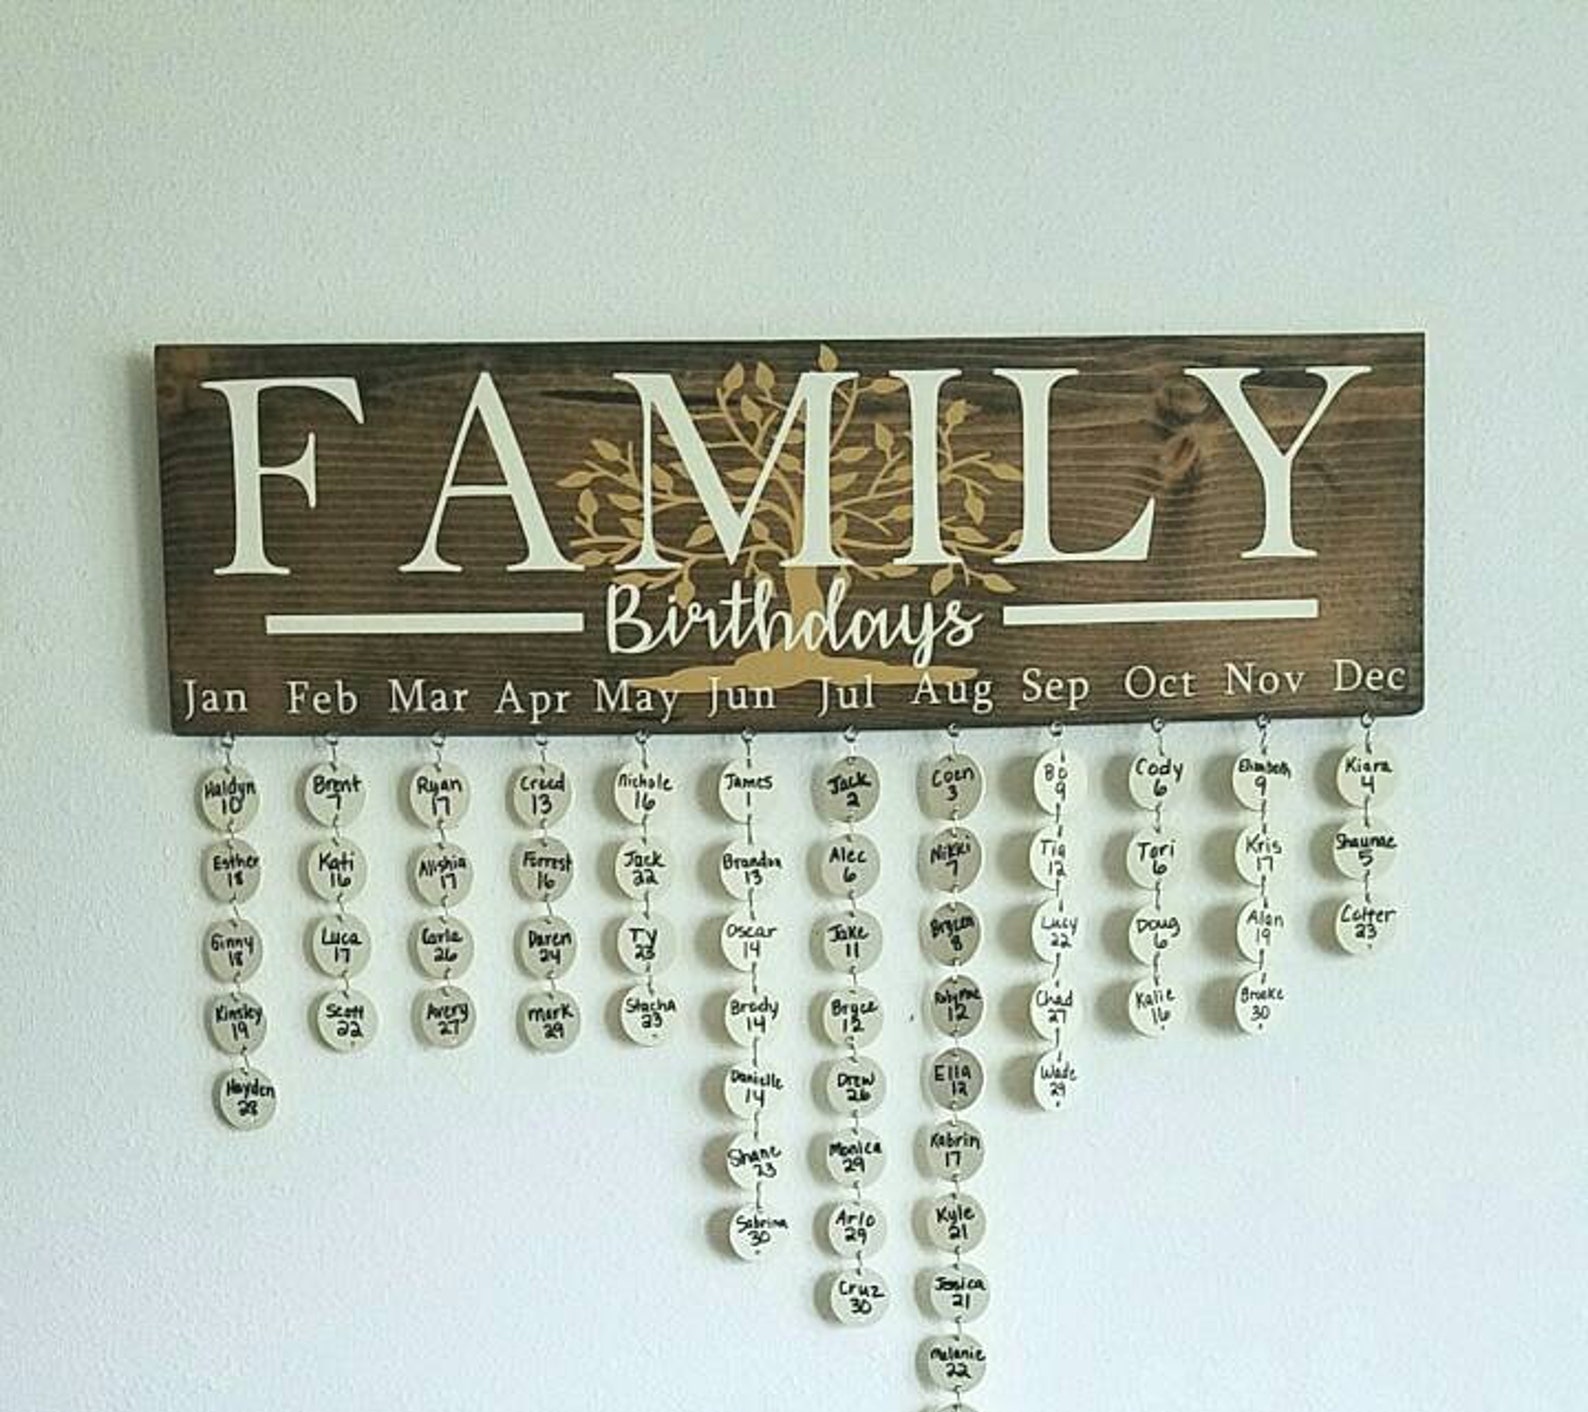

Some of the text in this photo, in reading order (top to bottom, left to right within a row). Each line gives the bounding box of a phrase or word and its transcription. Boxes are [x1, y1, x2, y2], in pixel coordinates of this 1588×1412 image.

[200, 364, 1372, 577] FAMILY
[605, 573, 983, 667] Birthdays
[1123, 665, 1197, 700] Oct
[1225, 661, 1306, 698] Nov
[1333, 658, 1407, 692] Dec
[389, 679, 470, 715] Mar
[706, 676, 777, 718] Jun
[817, 675, 876, 718] Jul
[910, 671, 995, 712] Aug
[1021, 667, 1092, 710] Sep
[183, 678, 249, 721] Jan
[286, 680, 359, 716] Feb
[494, 680, 571, 723] Apr
[594, 679, 679, 723] May
[932, 767, 975, 787] Coen
[1043, 764, 1068, 782] Bo
[1135, 758, 1183, 782] Cody
[313, 774, 362, 794] Brent
[417, 776, 462, 797] Ryan
[724, 773, 773, 789] James
[827, 771, 872, 794] Jack
[1153, 779, 1167, 796] 6
[1254, 776, 1266, 796] 9
[1361, 776, 1375, 794] 4
[846, 792, 860, 807] 2
[946, 786, 958, 801] 3
[1055, 781, 1066, 801] 9
[222, 797, 243, 814] 10
[326, 794, 342, 810] 7
[432, 796, 451, 816] 17
[532, 794, 552, 815] 13
[635, 792, 655, 810] 16
[1138, 839, 1176, 861] Tori
[1246, 833, 1283, 854] Kris
[319, 852, 355, 871] Kati
[624, 851, 666, 868] Jack
[829, 848, 867, 863] Alec
[1256, 855, 1273, 872] 17
[1358, 850, 1373, 867] 5
[843, 867, 856, 883] 6
[945, 860, 958, 876] 7
[1048, 861, 1066, 876] 12
[1153, 860, 1167, 875] 6
[330, 874, 351, 887] 16
[441, 874, 457, 889] 17
[537, 872, 556, 890] 16
[632, 870, 659, 886] 22
[744, 871, 763, 885] 13
[1041, 916, 1078, 935] Lucy
[1136, 917, 1181, 937] Doug
[1246, 910, 1285, 928] Alan
[321, 928, 362, 944] Luca
[727, 924, 777, 938] Oscar
[827, 924, 869, 942] Jake
[1256, 928, 1271, 946] 19
[1355, 924, 1377, 939] 23
[951, 935, 963, 951] 8
[1050, 933, 1072, 948] 22
[1154, 933, 1168, 949] 6
[334, 948, 350, 963] 17
[433, 948, 458, 962] 26
[539, 949, 561, 964] 24
[743, 940, 760, 959] 14
[846, 943, 859, 958] 11
[326, 1004, 364, 1019] Scott
[948, 1003, 970, 1021] 12
[1151, 1008, 1171, 1024] 16
[1251, 1005, 1270, 1021] 30
[337, 1021, 364, 1037] 22
[438, 1020, 460, 1035] 27
[641, 1013, 663, 1028] 23
[747, 1016, 766, 1033] 14
[842, 1017, 865, 1033] 12
[232, 1021, 249, 1040] 19
[543, 1023, 564, 1039] 29
[935, 1064, 971, 1081] Ella
[1041, 1062, 1077, 1081] Wade
[952, 1081, 968, 1096] 12
[1050, 1083, 1066, 1097] 29
[745, 1088, 764, 1108] 14
[843, 1158, 865, 1174] 29
[944, 1151, 961, 1167] 17
[836, 1209, 876, 1227] Arlo
[936, 1207, 975, 1226] Kyle
[749, 1230, 770, 1246] 30
[844, 1227, 867, 1244] 29
[948, 1225, 968, 1240] 21
[839, 1281, 885, 1298] Cruz
[850, 1298, 872, 1315] 30
[952, 1294, 970, 1309] 21
[945, 1363, 971, 1379] 22
